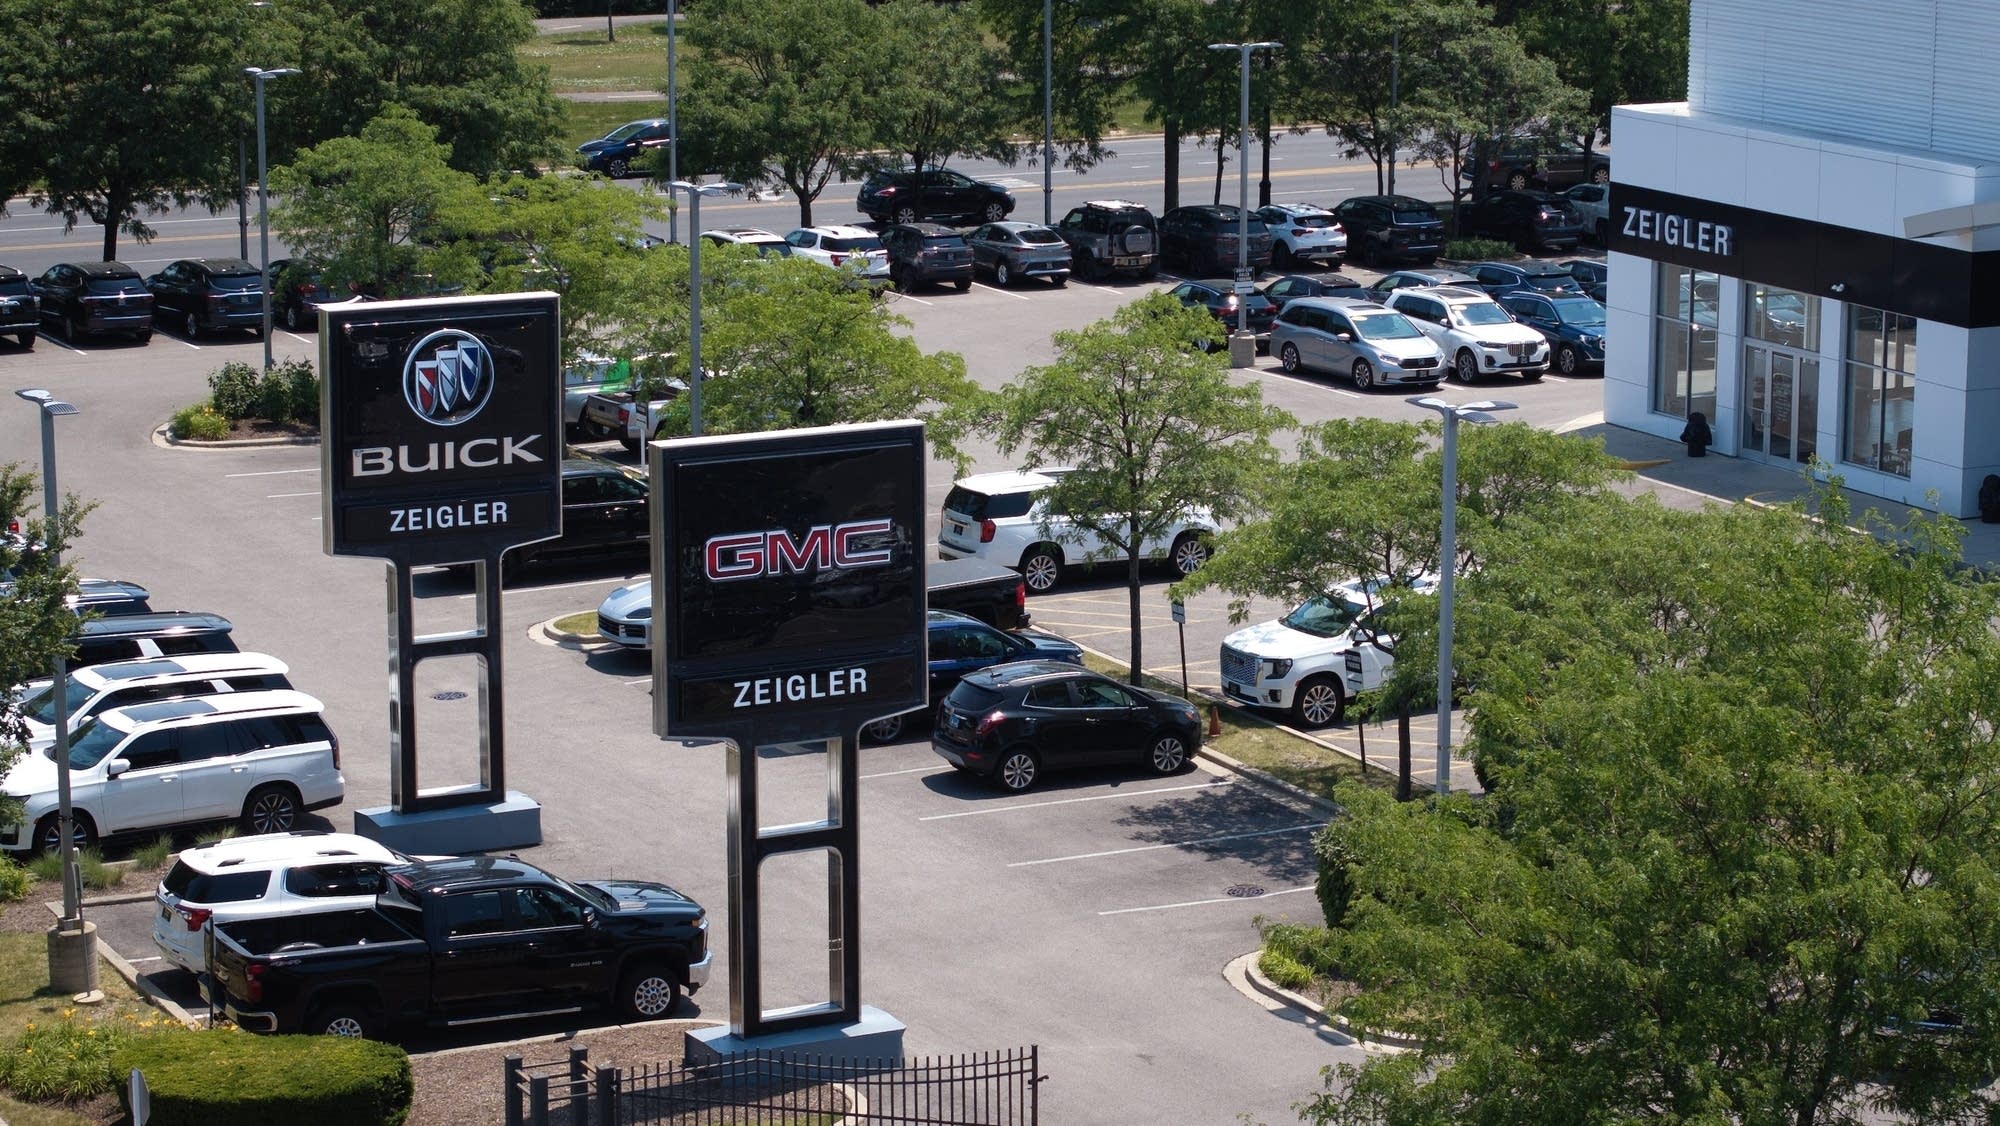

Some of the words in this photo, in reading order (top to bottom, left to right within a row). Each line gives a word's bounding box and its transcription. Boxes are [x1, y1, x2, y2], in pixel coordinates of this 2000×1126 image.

[1622, 206, 1730, 256] ZEIGLER
[352, 434, 544, 477] BUICK
[389, 501, 508, 532] ZEIGLER
[705, 518, 893, 581] GMC
[733, 667, 868, 708] ZEIGLER
